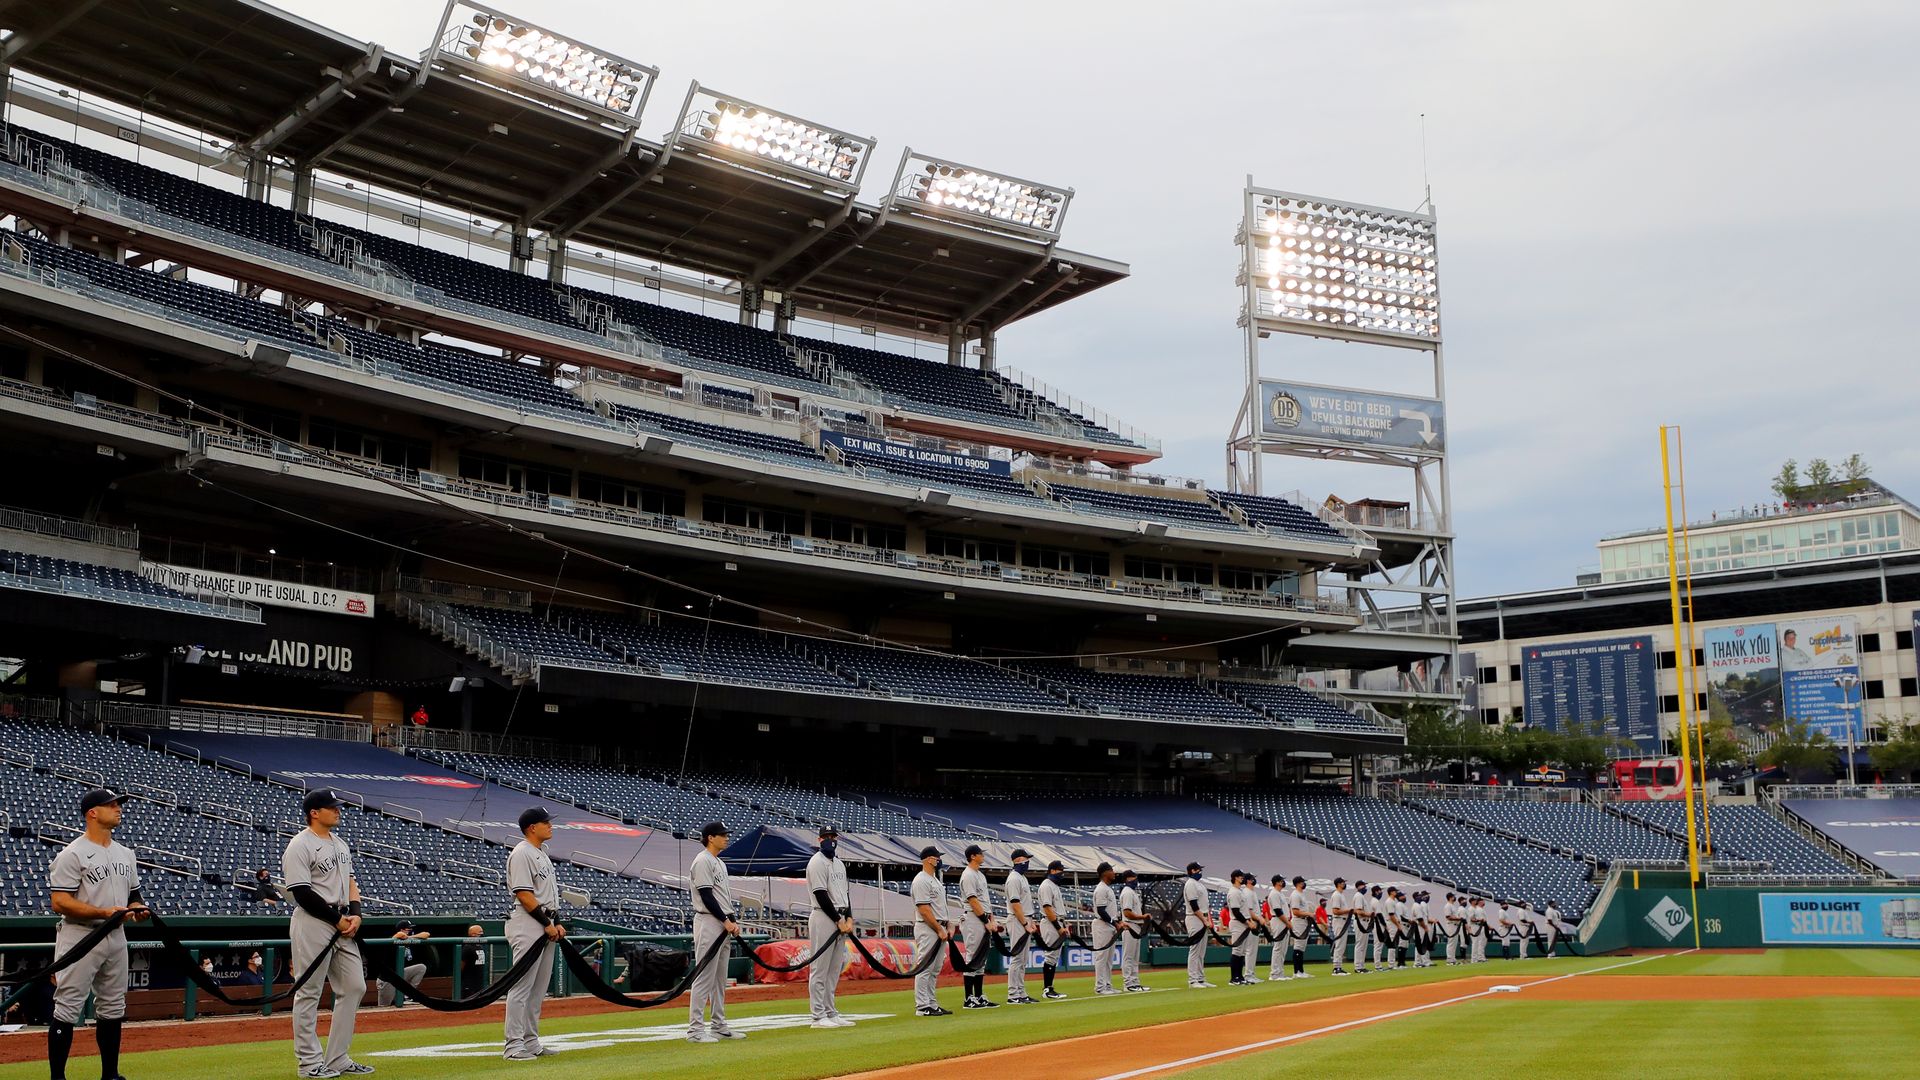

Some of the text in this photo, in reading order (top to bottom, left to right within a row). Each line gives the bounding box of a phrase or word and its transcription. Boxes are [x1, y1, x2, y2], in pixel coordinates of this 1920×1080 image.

[122, 131, 135, 140] 405
[406, 217, 418, 226] 404
[1277, 400, 1295, 418] DB
[1309, 397, 1394, 417] WE'VE GOT BEER.
[1311, 411, 1343, 425] DEVILS
[1345, 415, 1392, 430] BACKBONE
[1321, 425, 1383, 439] BREWING COMPANY
[843, 436, 990, 470] TEXT NATS, ISSUE & LOCATION TO 69050
[170, 570, 191, 587] NOT
[194, 574, 235, 593] CHANGE
[238, 581, 252, 595] UP
[255, 583, 273, 599] THE
[313, 591, 337, 607] D.C.?
[1541, 649, 1571, 657] WASHINGTON
[1579, 646, 1597, 654] SPORTS
[1618, 643, 1631, 651] FAME
[1712, 636, 1770, 659] THANK YOU
[314, 644, 352, 672] PUB
[1712, 656, 1771, 667] NATS FANS
[86, 863, 111, 885] NEW
[318, 857, 338, 874] NEW
[1790, 902, 1861, 911] BUD LIGHT
[1704, 918, 1722, 934] 336
[1791, 911, 1864, 935] SELTZER
[130, 941, 165, 949] nationals.co
[1068, 949, 1121, 967] GEO
